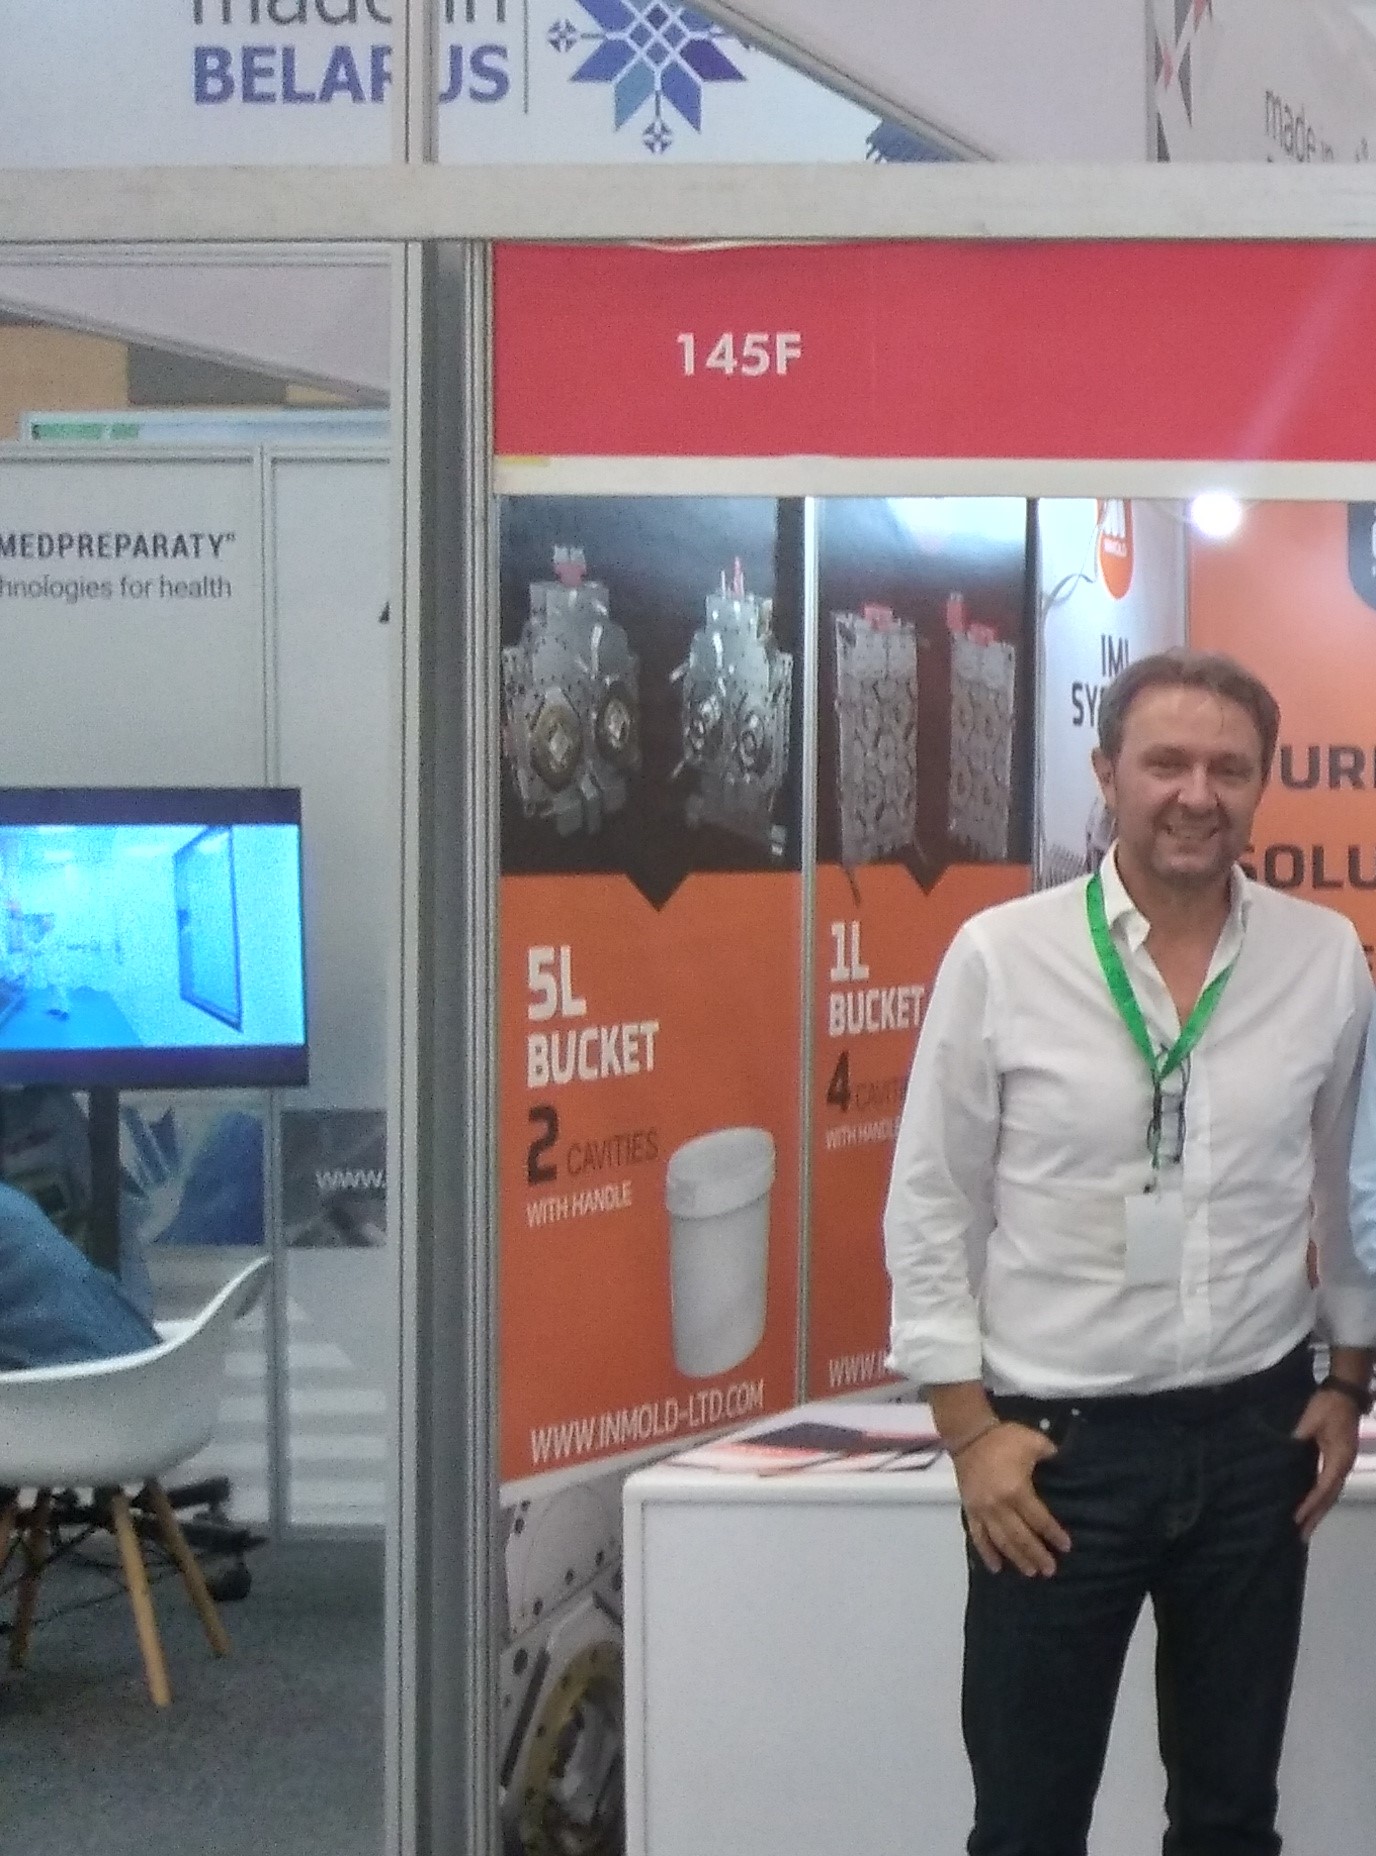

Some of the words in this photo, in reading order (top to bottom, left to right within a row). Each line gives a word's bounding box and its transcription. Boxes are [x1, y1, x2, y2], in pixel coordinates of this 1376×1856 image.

[676, 331, 802, 376] 145F
[120, 573, 152, 599] for
[159, 574, 233, 599] health
[527, 944, 588, 1022] 5L
[830, 919, 870, 983] 1L
[829, 984, 925, 1038] BUCKET
[527, 1019, 661, 1089] BUCKET
[826, 1050, 851, 1114] 4
[526, 1103, 560, 1187] 2
[566, 1127, 660, 1177] CAVITIES
[526, 1196, 568, 1228] WITH
[572, 1180, 632, 1218] HANDLE
[530, 1379, 766, 1465] WWW.INMOLD-LTD.COM
